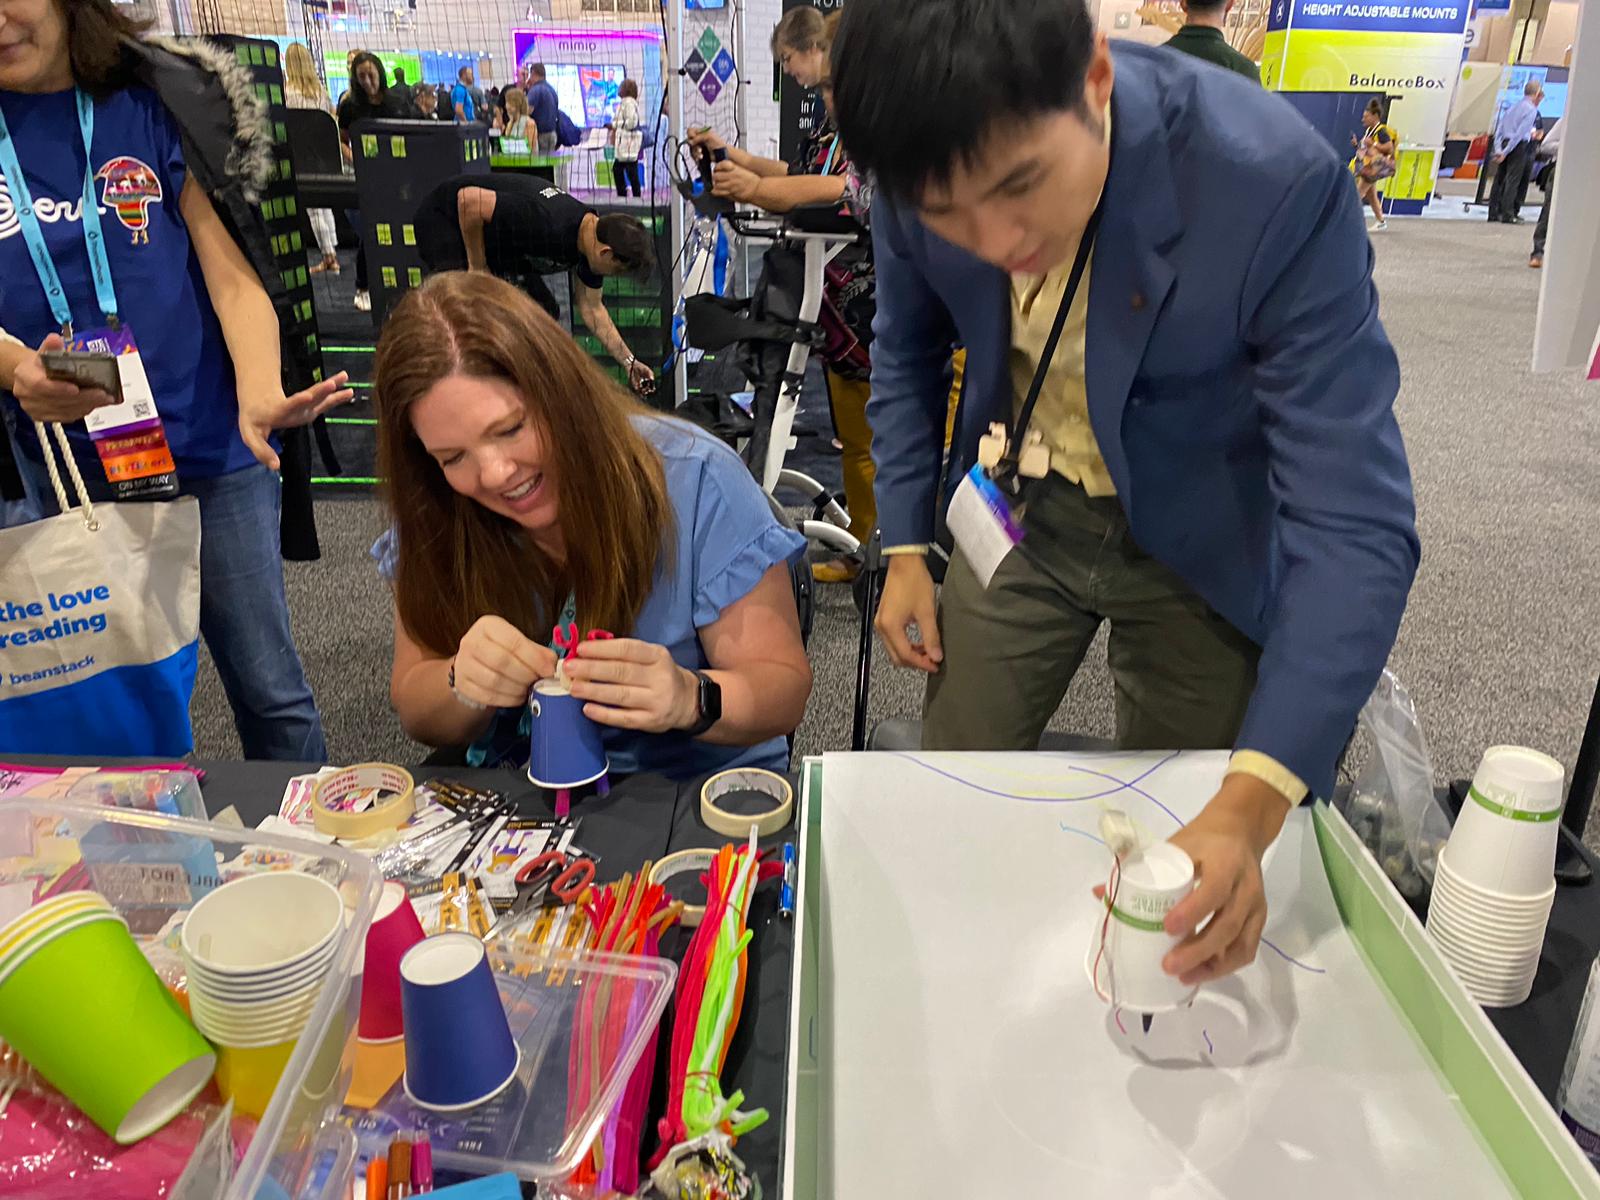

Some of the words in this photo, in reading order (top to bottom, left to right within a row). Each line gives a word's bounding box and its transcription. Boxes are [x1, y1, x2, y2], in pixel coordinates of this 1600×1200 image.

[1302, 3, 1343, 16] HEIGHT
[1343, 4, 1410, 18] ADJUSTABLE
[1411, 7, 1458, 20] MOUNTS
[558, 40, 597, 51] mimio
[1349, 73, 1447, 89] BalanceBox
[0, 601, 44, 622] the
[47, 585, 110, 612] love
[0, 613, 107, 649] reading
[9, 655, 95, 685] beanstack
